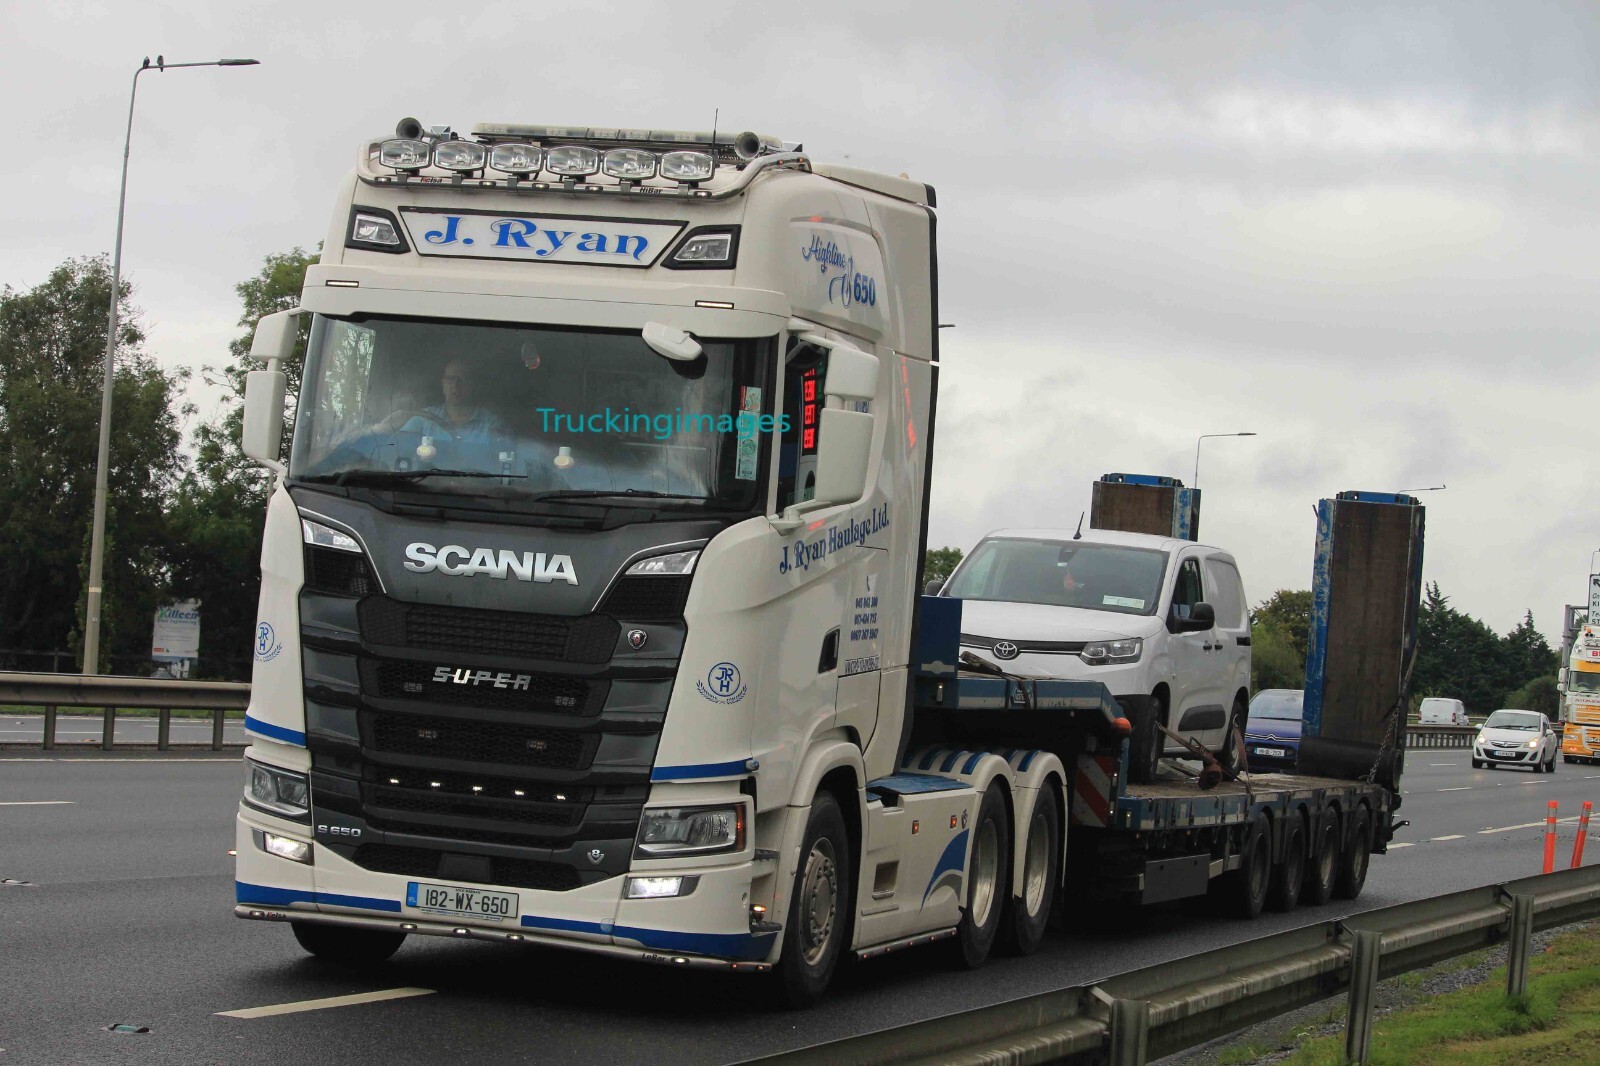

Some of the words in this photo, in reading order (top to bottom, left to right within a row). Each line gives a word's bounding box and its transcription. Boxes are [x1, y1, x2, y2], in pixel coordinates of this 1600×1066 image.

[639, 186, 662, 195] HiBar
[424, 216, 474, 245] J.
[490, 218, 650, 261] Ryan
[802, 234, 846, 273] Highline
[853, 272, 876, 307] 650
[779, 545, 793, 575] J.
[793, 538, 827, 571] Ryan
[828, 517, 871, 554] Haulage
[872, 502, 890, 533] Ltd.
[403, 541, 579, 586] SCANIA
[432, 666, 532, 691] SUPER
[317, 824, 328, 834] S
[330, 825, 362, 837] 650
[425, 889, 510, 915] 182-WX-650
[641, 952, 667, 963] LoBar
